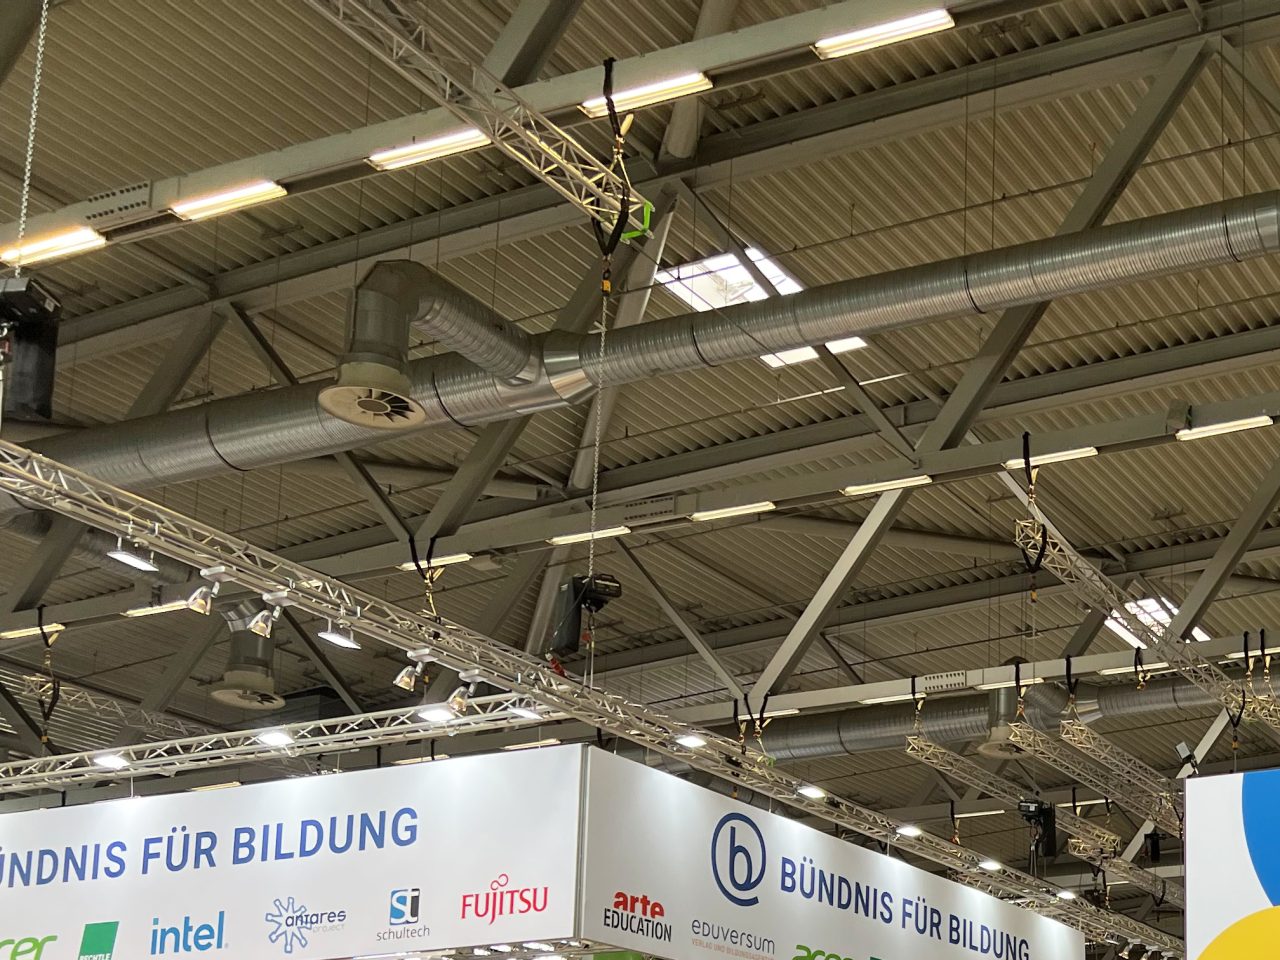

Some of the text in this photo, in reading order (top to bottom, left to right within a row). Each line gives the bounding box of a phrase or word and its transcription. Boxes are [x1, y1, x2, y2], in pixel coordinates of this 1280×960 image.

[0, 807, 418, 888] NDNIS FÜR BILDUNG
[461, 874, 549, 925] FUJITSU
[613, 891, 665, 918] arte
[780, 856, 894, 924] BÜNDNIS
[901, 896, 942, 940] FÜR
[150, 911, 225, 955] intel
[285, 910, 347, 927] antares
[376, 925, 431, 941] schultech
[603, 908, 672, 942] EDUCATION
